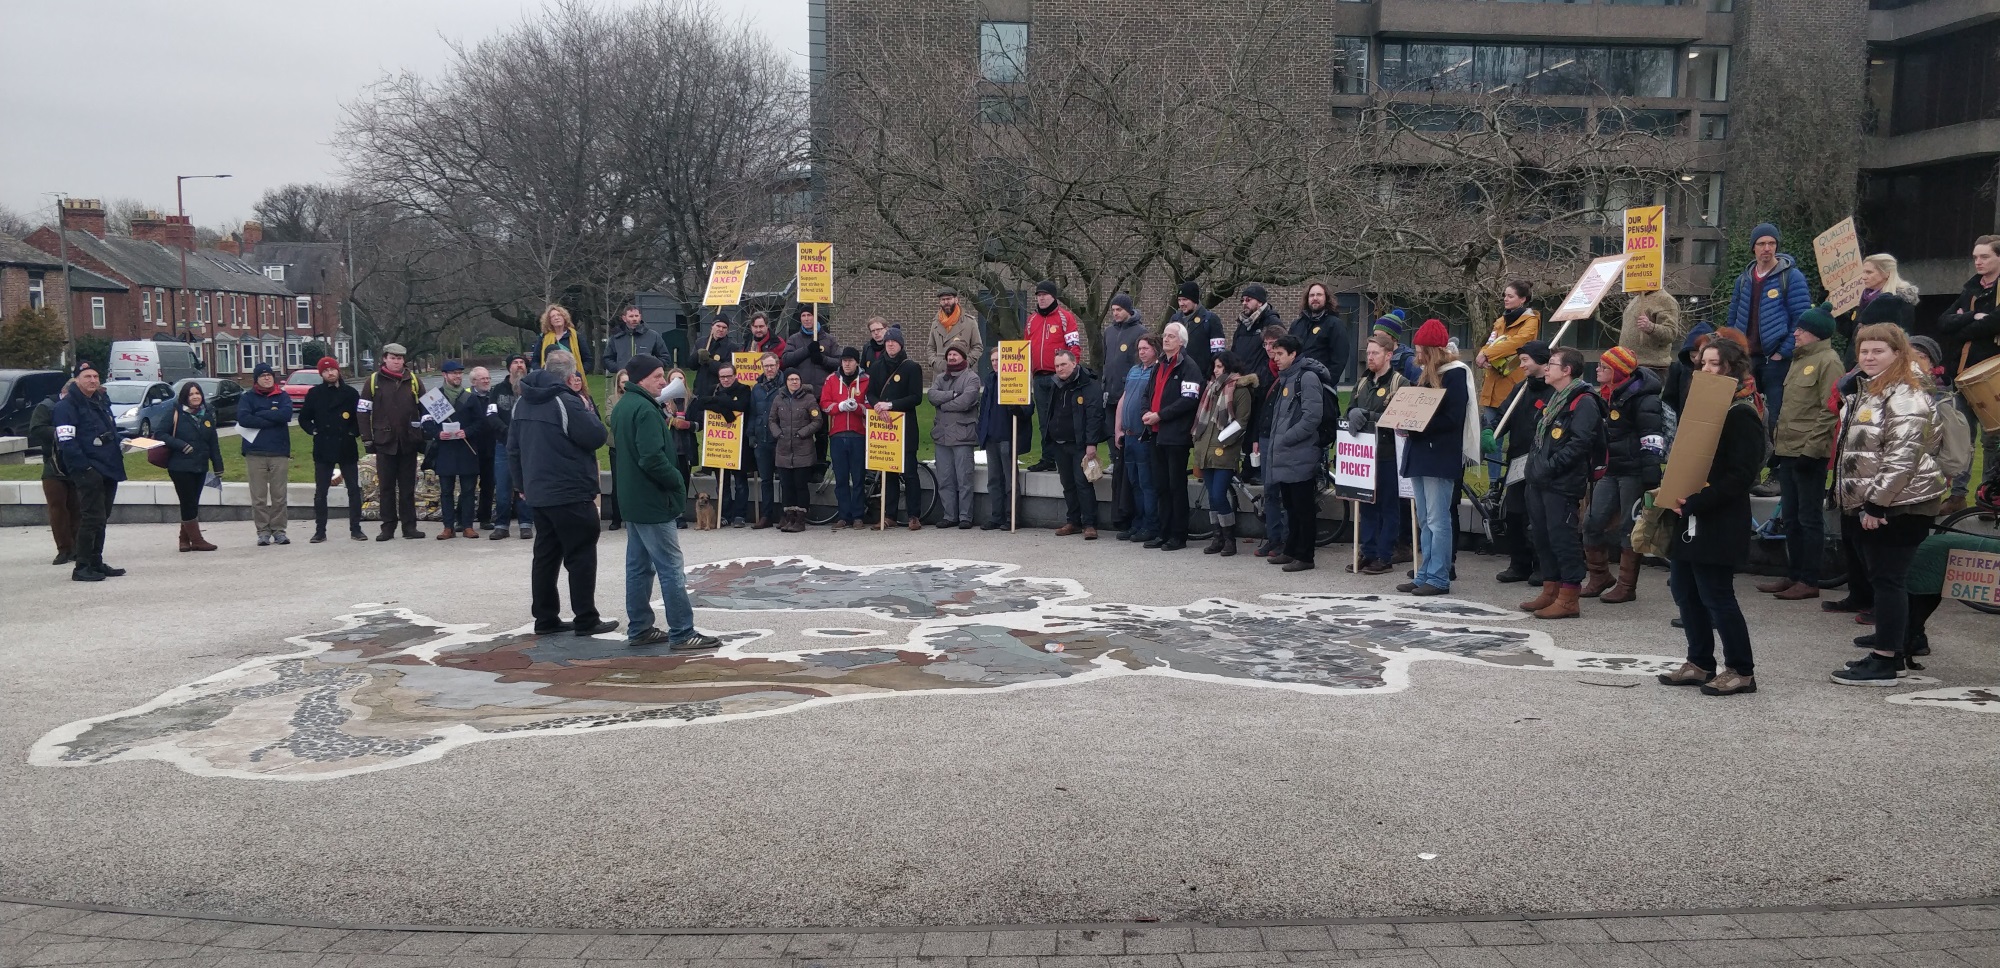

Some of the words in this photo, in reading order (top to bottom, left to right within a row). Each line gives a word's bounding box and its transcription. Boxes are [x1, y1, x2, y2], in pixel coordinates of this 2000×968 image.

[1628, 216, 1641, 224] OUR
[1627, 225, 1658, 234] PENSION
[1819, 220, 1851, 247] QUALITY
[1627, 236, 1659, 250] AXED.
[1821, 232, 1856, 256] PENSIONS
[1822, 248, 1856, 275] QUALITY
[801, 264, 828, 273] AXED.
[1825, 260, 1859, 286] EDUCATION
[713, 276, 740, 284] AXED.
[1001, 363, 1026, 372] AXED.
[707, 421, 737, 429] PENSION
[870, 422, 899, 430] PENSION
[707, 429, 738, 440] AXED.
[870, 431, 900, 442] AXED.
[1338, 442, 1374, 459] OFFICIAL
[1341, 461, 1371, 478] PICKET
[1947, 569, 1995, 584] SHOULD
[1951, 583, 1990, 601] SAFE
